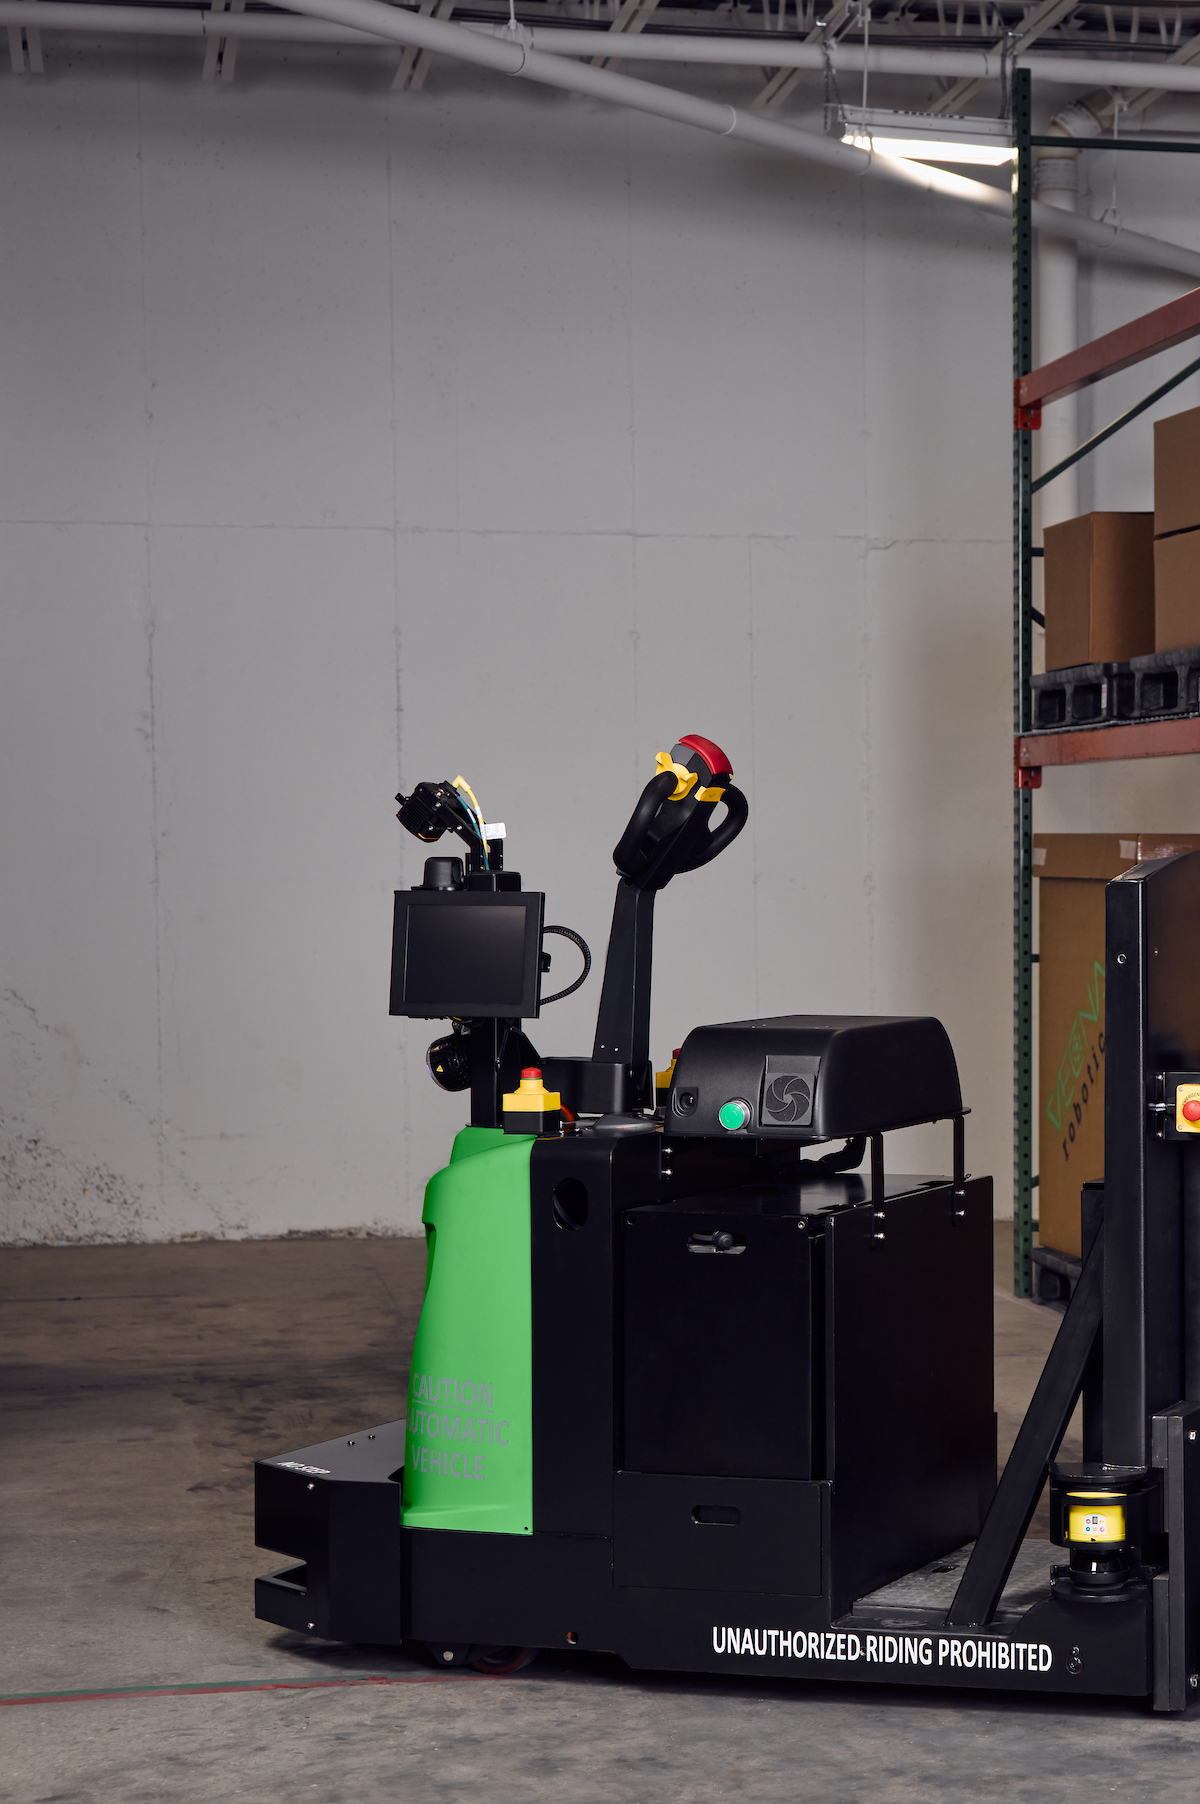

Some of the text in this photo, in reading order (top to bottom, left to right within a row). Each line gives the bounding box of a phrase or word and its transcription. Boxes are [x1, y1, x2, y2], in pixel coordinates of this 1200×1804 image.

[1062, 1031, 1106, 1161] robotic
[412, 1372, 493, 1408] CAUTION
[406, 1406, 510, 1446] AUTOMATIC
[412, 1444, 485, 1480] VEHICLE
[712, 1626, 1052, 1672] UNAUTHORIZED RIDING PROHIBITED
